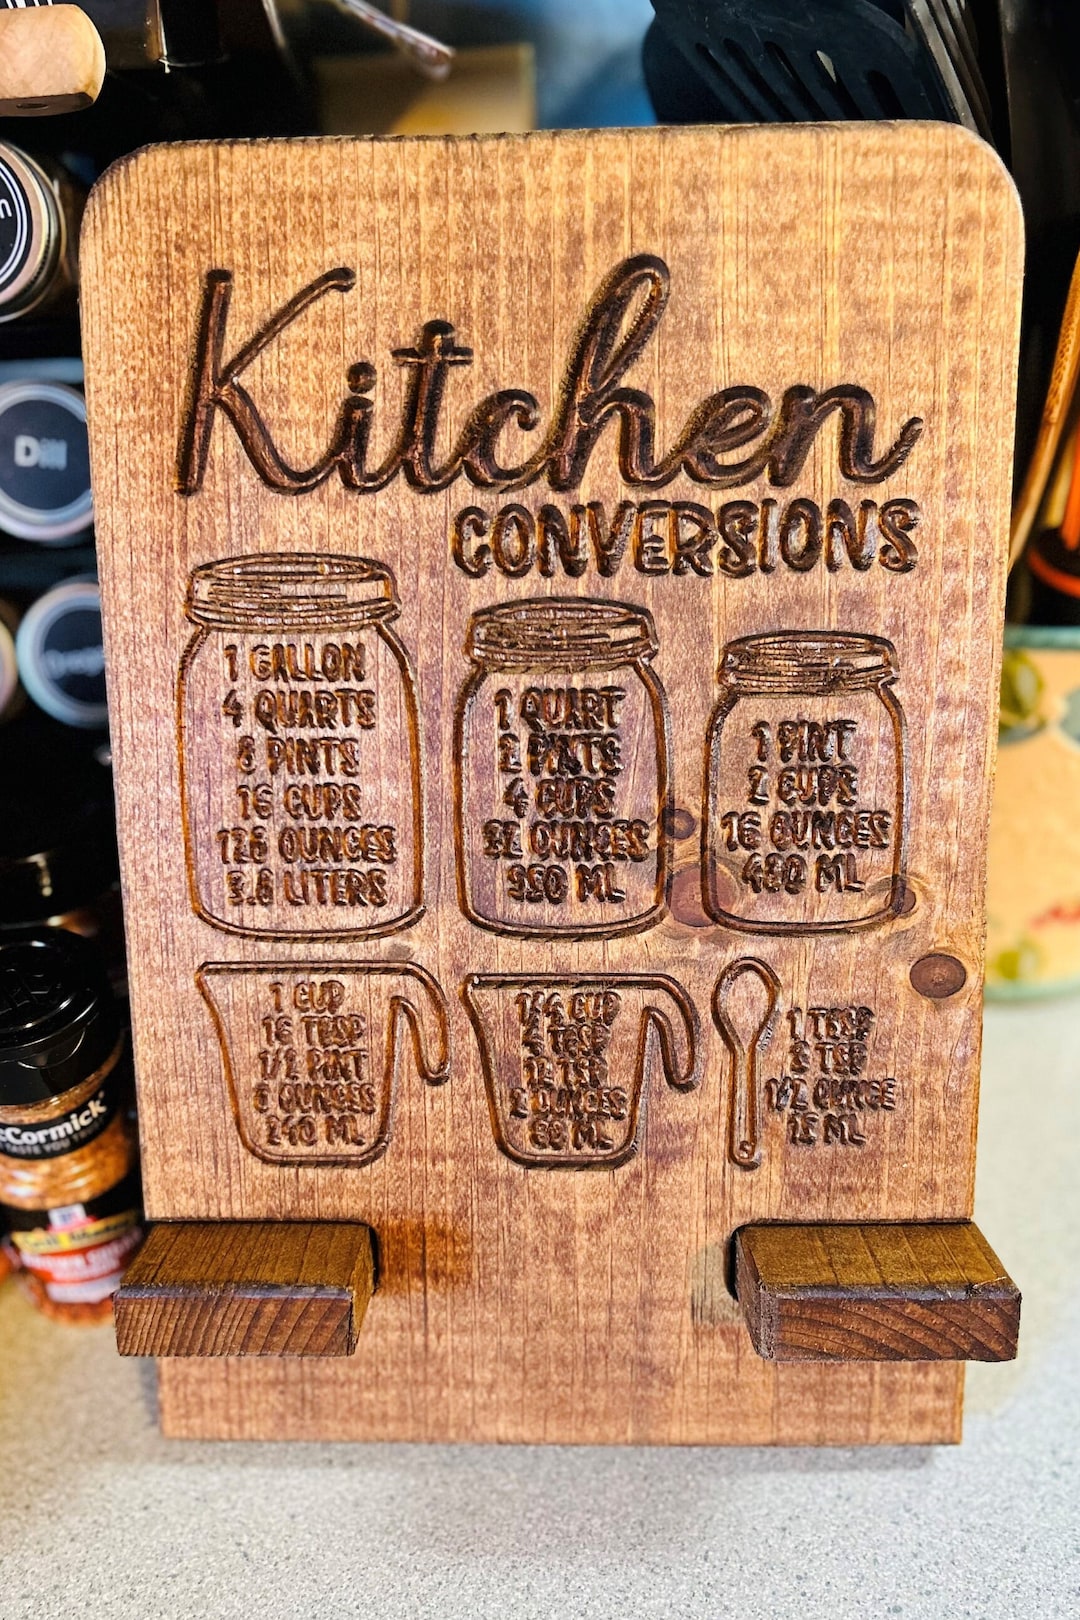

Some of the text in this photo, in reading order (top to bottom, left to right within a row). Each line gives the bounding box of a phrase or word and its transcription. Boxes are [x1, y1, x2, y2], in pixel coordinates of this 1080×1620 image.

[174, 253, 922, 496] Kitchen
[452, 497, 920, 579] CONVERSIONS
[223, 642, 366, 683] 1 GALLON
[222, 688, 376, 734] 4 QUARTS
[494, 686, 627, 732] 1 QUART
[237, 735, 359, 777] 8 PINTS
[498, 733, 625, 776] 2 PINTS
[751, 719, 858, 763] 1 PINT
[236, 782, 362, 821] 16 CUPS
[503, 776, 617, 819] 4 CUPS
[748, 764, 859, 806] 2 CUPS
[278, 823, 397, 864] OUNCES
[528, 819, 650, 862] OUNCES
[720, 810, 892, 851] 16 OUNCES
[283, 868, 388, 907] LITERS
[575, 862, 626, 904] ML
[815, 852, 865, 893] ML
[269, 980, 345, 1014] 1 CUP
[568, 991, 622, 1026] CUP
[262, 1016, 293, 1046] 16
[786, 1006, 803, 1040] 1
[307, 1048, 369, 1081] PINT
[279, 1082, 377, 1115] OUNCES
[530, 1087, 628, 1120] OUNCES
[813, 1077, 897, 1111] OUNCE
[325, 1114, 366, 1146] ML
[571, 1119, 614, 1150] ML
[823, 1113, 867, 1146] ML
